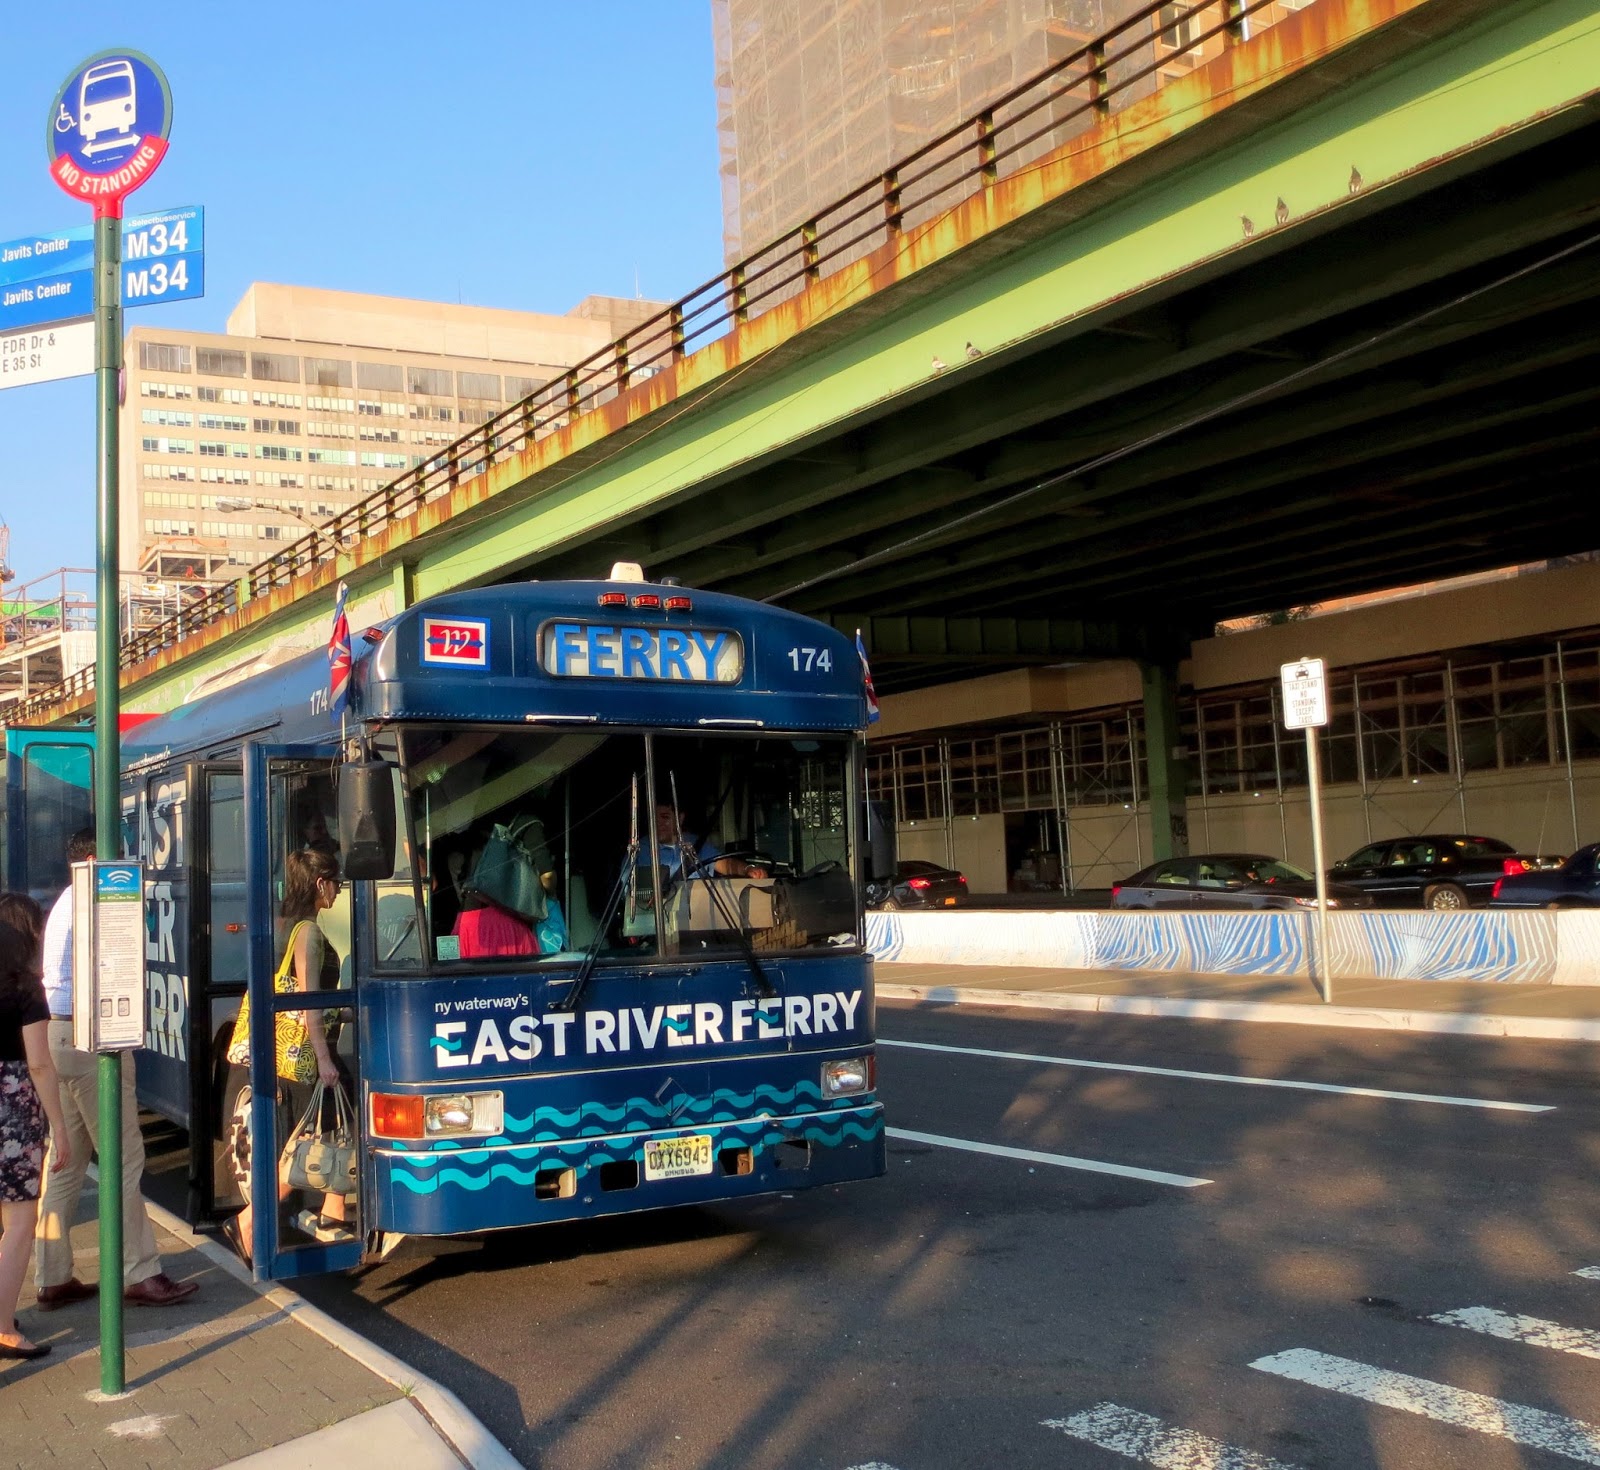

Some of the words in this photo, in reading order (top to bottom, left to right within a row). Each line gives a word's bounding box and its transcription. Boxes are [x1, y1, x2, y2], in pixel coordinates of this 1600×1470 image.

[58, 162, 80, 187] NO
[80, 145, 156, 194] STANDING
[1, 246, 32, 263] Javits
[35, 238, 70, 254] Center
[127, 221, 188, 259] M34
[127, 260, 189, 298] M34
[3, 288, 34, 306] Javits
[37, 281, 72, 299] Center
[3, 336, 26, 354] FDR
[31, 334, 44, 350] Dr
[48, 332, 56, 346] &
[3, 359, 9, 373] E
[13, 356, 26, 371] 35
[30, 354, 41, 368] St
[554, 624, 728, 681] FERRY
[787, 647, 832, 673] 174
[1300, 690, 1308, 698] NO
[1301, 680, 1318, 690] STAND
[310, 686, 328, 716] 174
[1292, 698, 1317, 708] STANDING
[1296, 706, 1315, 716] EXCEPT
[435, 1000, 451, 1016] ny
[455, 993, 529, 1012] waterway's
[432, 1013, 576, 1068] EAST
[585, 1003, 724, 1055] RIVER
[732, 990, 862, 1042] FERRY
